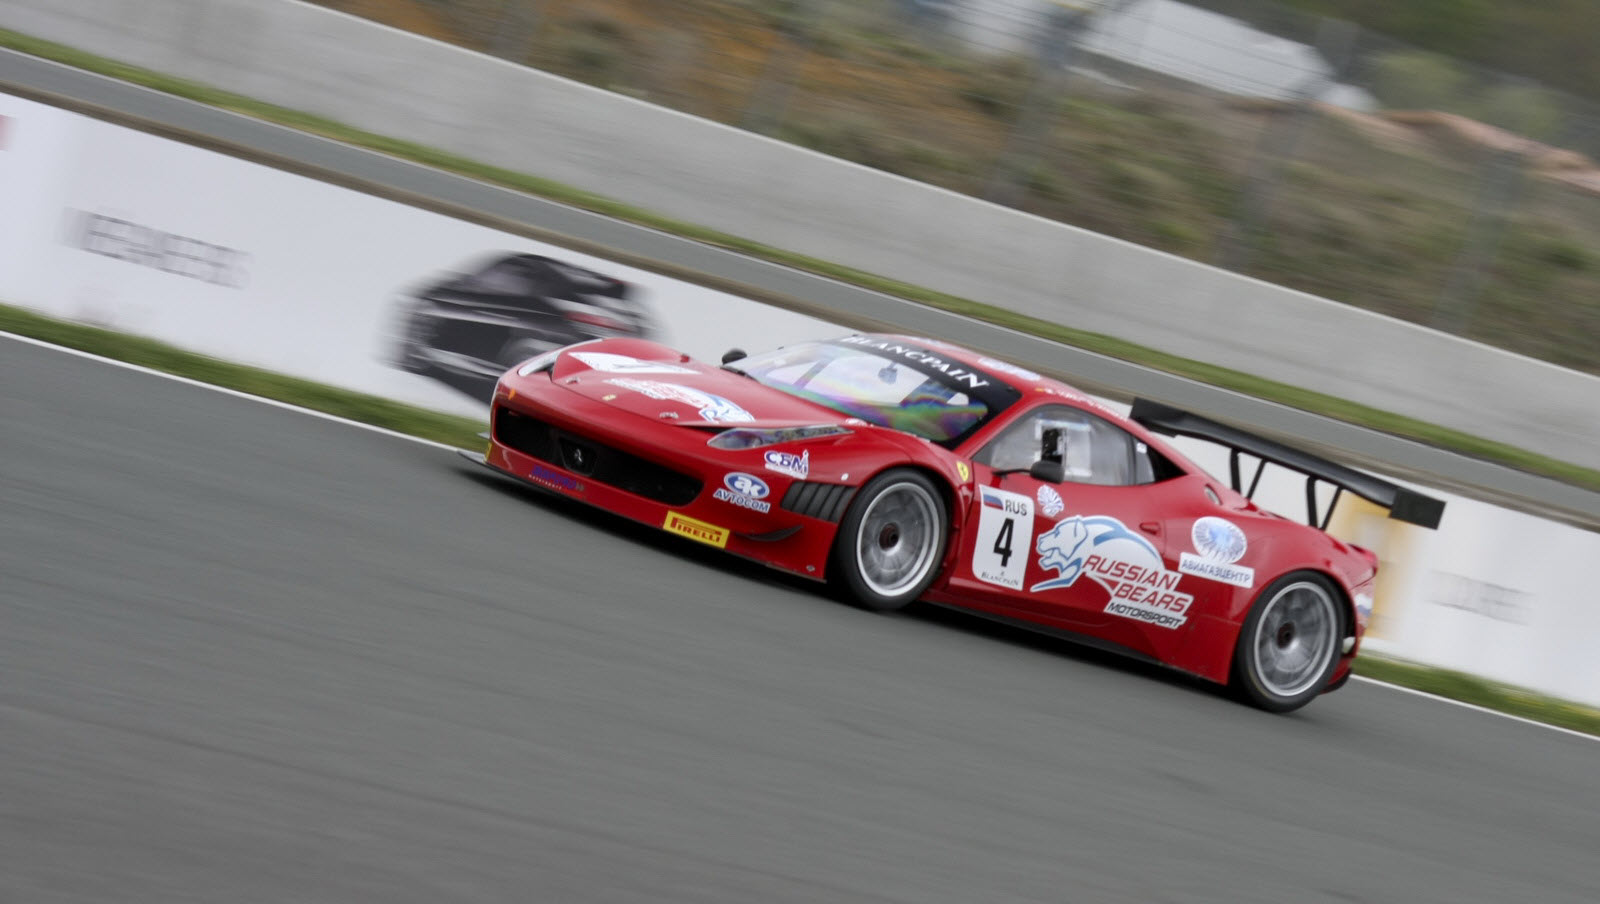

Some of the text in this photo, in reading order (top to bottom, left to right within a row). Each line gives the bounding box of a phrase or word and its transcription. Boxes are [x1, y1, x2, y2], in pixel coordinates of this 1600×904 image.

[840, 336, 990, 388] BLANCPAIN
[715, 489, 769, 512] AVTOCOM
[1005, 500, 1027, 516] RUS
[670, 517, 722, 543] PIRELLI
[993, 518, 1015, 567] 4
[1082, 555, 1178, 588] RUSSIAN
[1181, 558, 1251, 584] АВИАГАЗЦЕНТР
[1115, 583, 1189, 612] BEARS
[1107, 602, 1183, 628] MOTORSPORT
